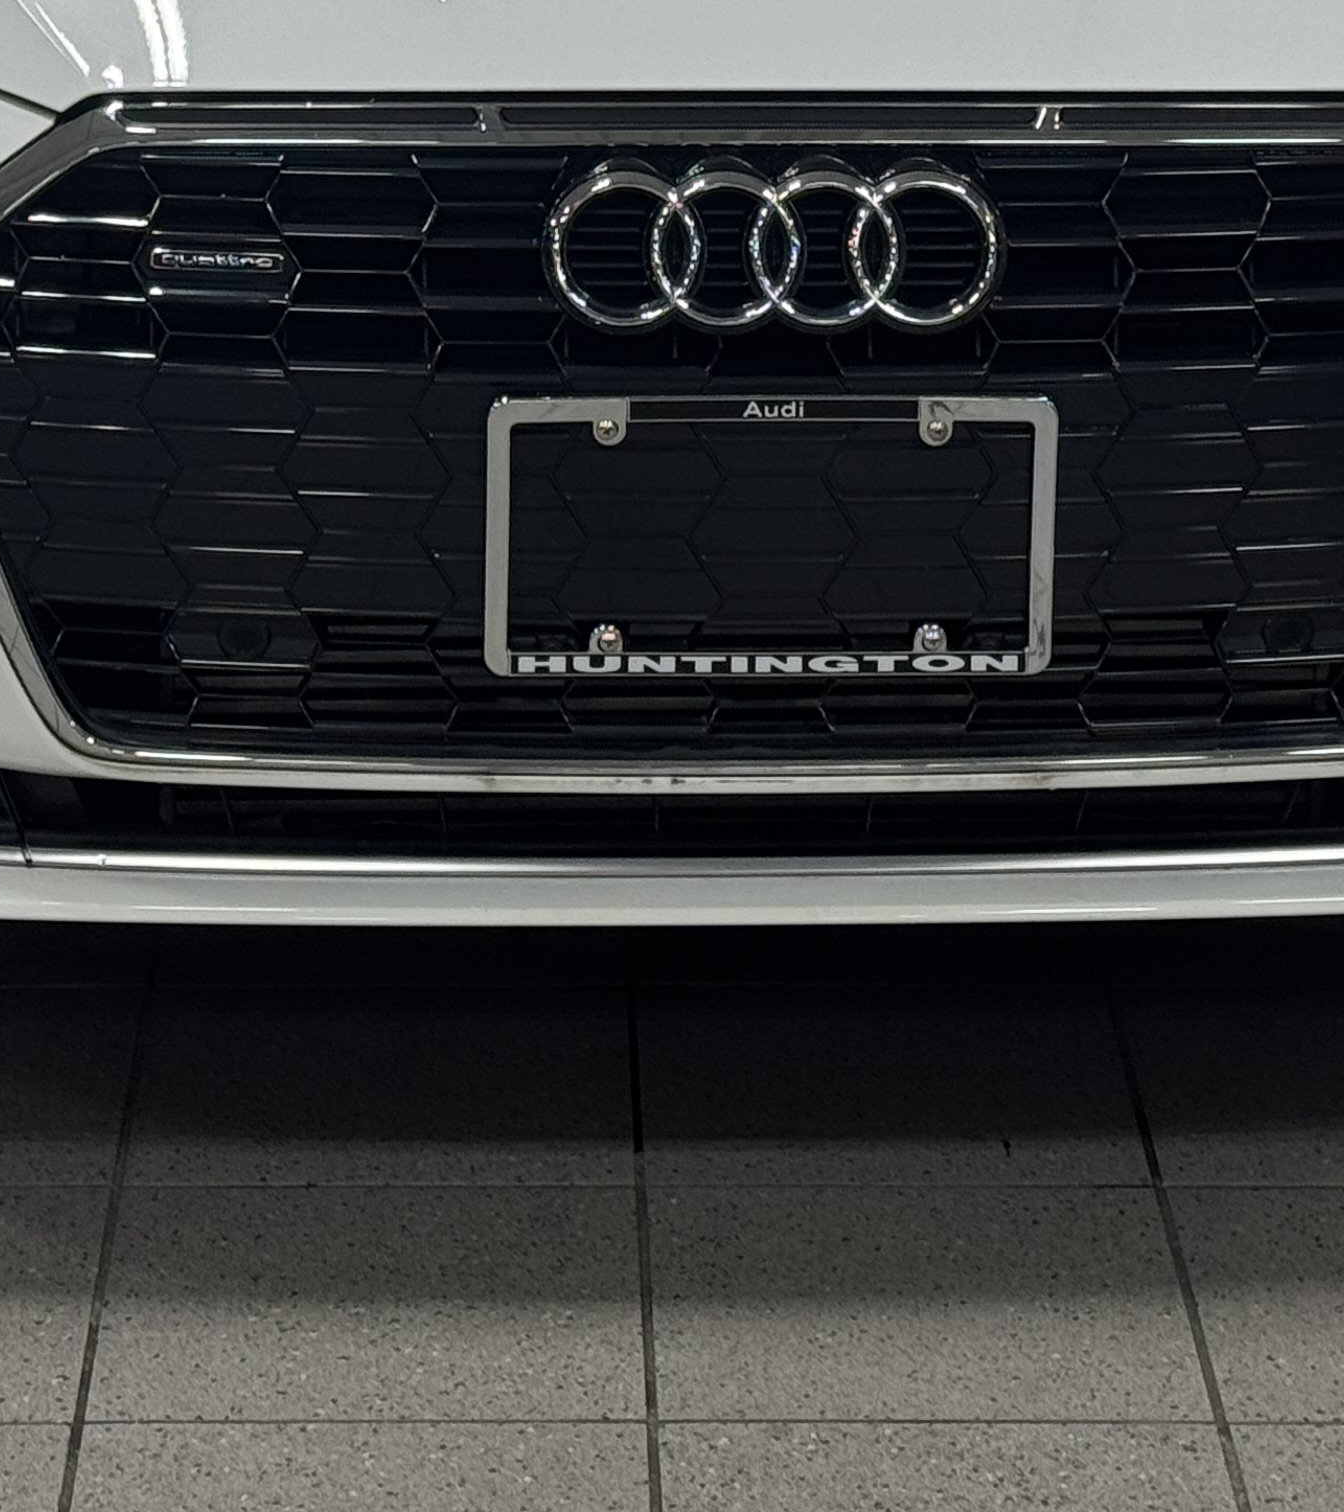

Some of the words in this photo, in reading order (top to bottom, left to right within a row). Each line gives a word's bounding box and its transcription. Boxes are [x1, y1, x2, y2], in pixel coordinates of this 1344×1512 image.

[161, 253, 274, 268] quattro
[742, 400, 805, 418] Audi
[517, 655, 1019, 674] HUNTINGTON
